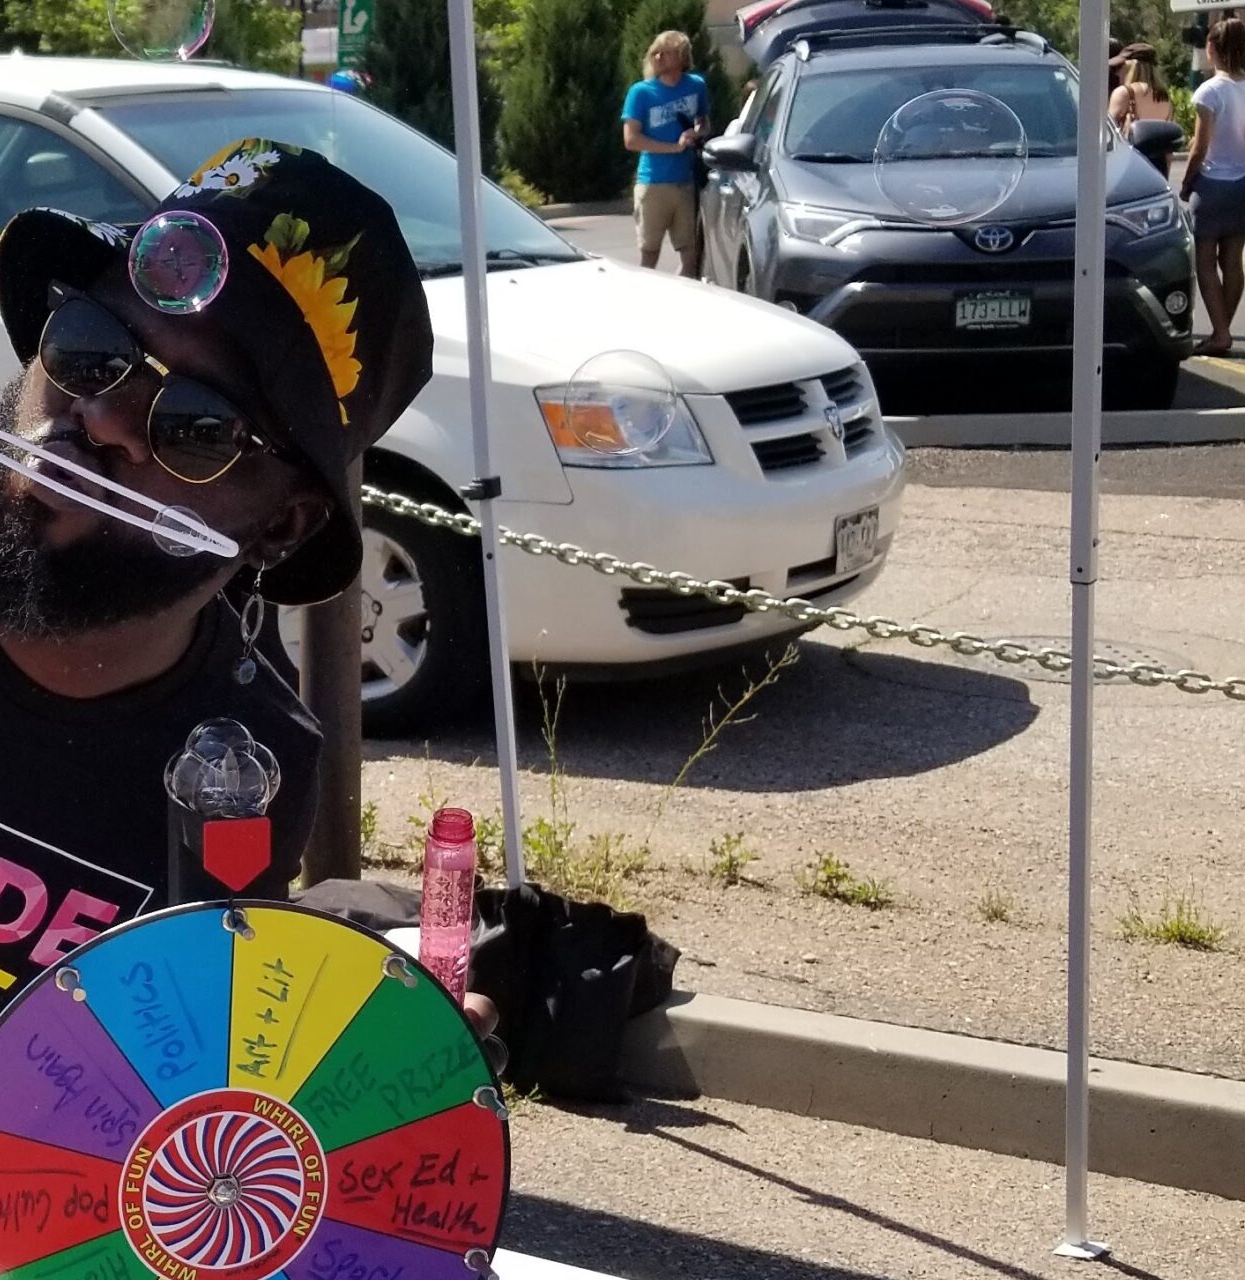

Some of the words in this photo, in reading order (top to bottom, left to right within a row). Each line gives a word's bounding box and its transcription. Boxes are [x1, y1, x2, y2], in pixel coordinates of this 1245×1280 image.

[256, 957, 295, 1003] Lit
[26, 1033, 87, 1111] Again
[307, 1051, 377, 1131] FREE
[379, 1030, 480, 1120] PRIZE
[84, 1096, 137, 1148] Spin
[253, 1097, 310, 1151] WHIRL
[126, 1147, 153, 1193] FUN
[304, 1154, 321, 1184] OF
[410, 1149, 461, 1188] Ed
[125, 1201, 144, 1230] OF
[292, 1190, 321, 1237] FUN
[392, 1193, 487, 1234] Health
